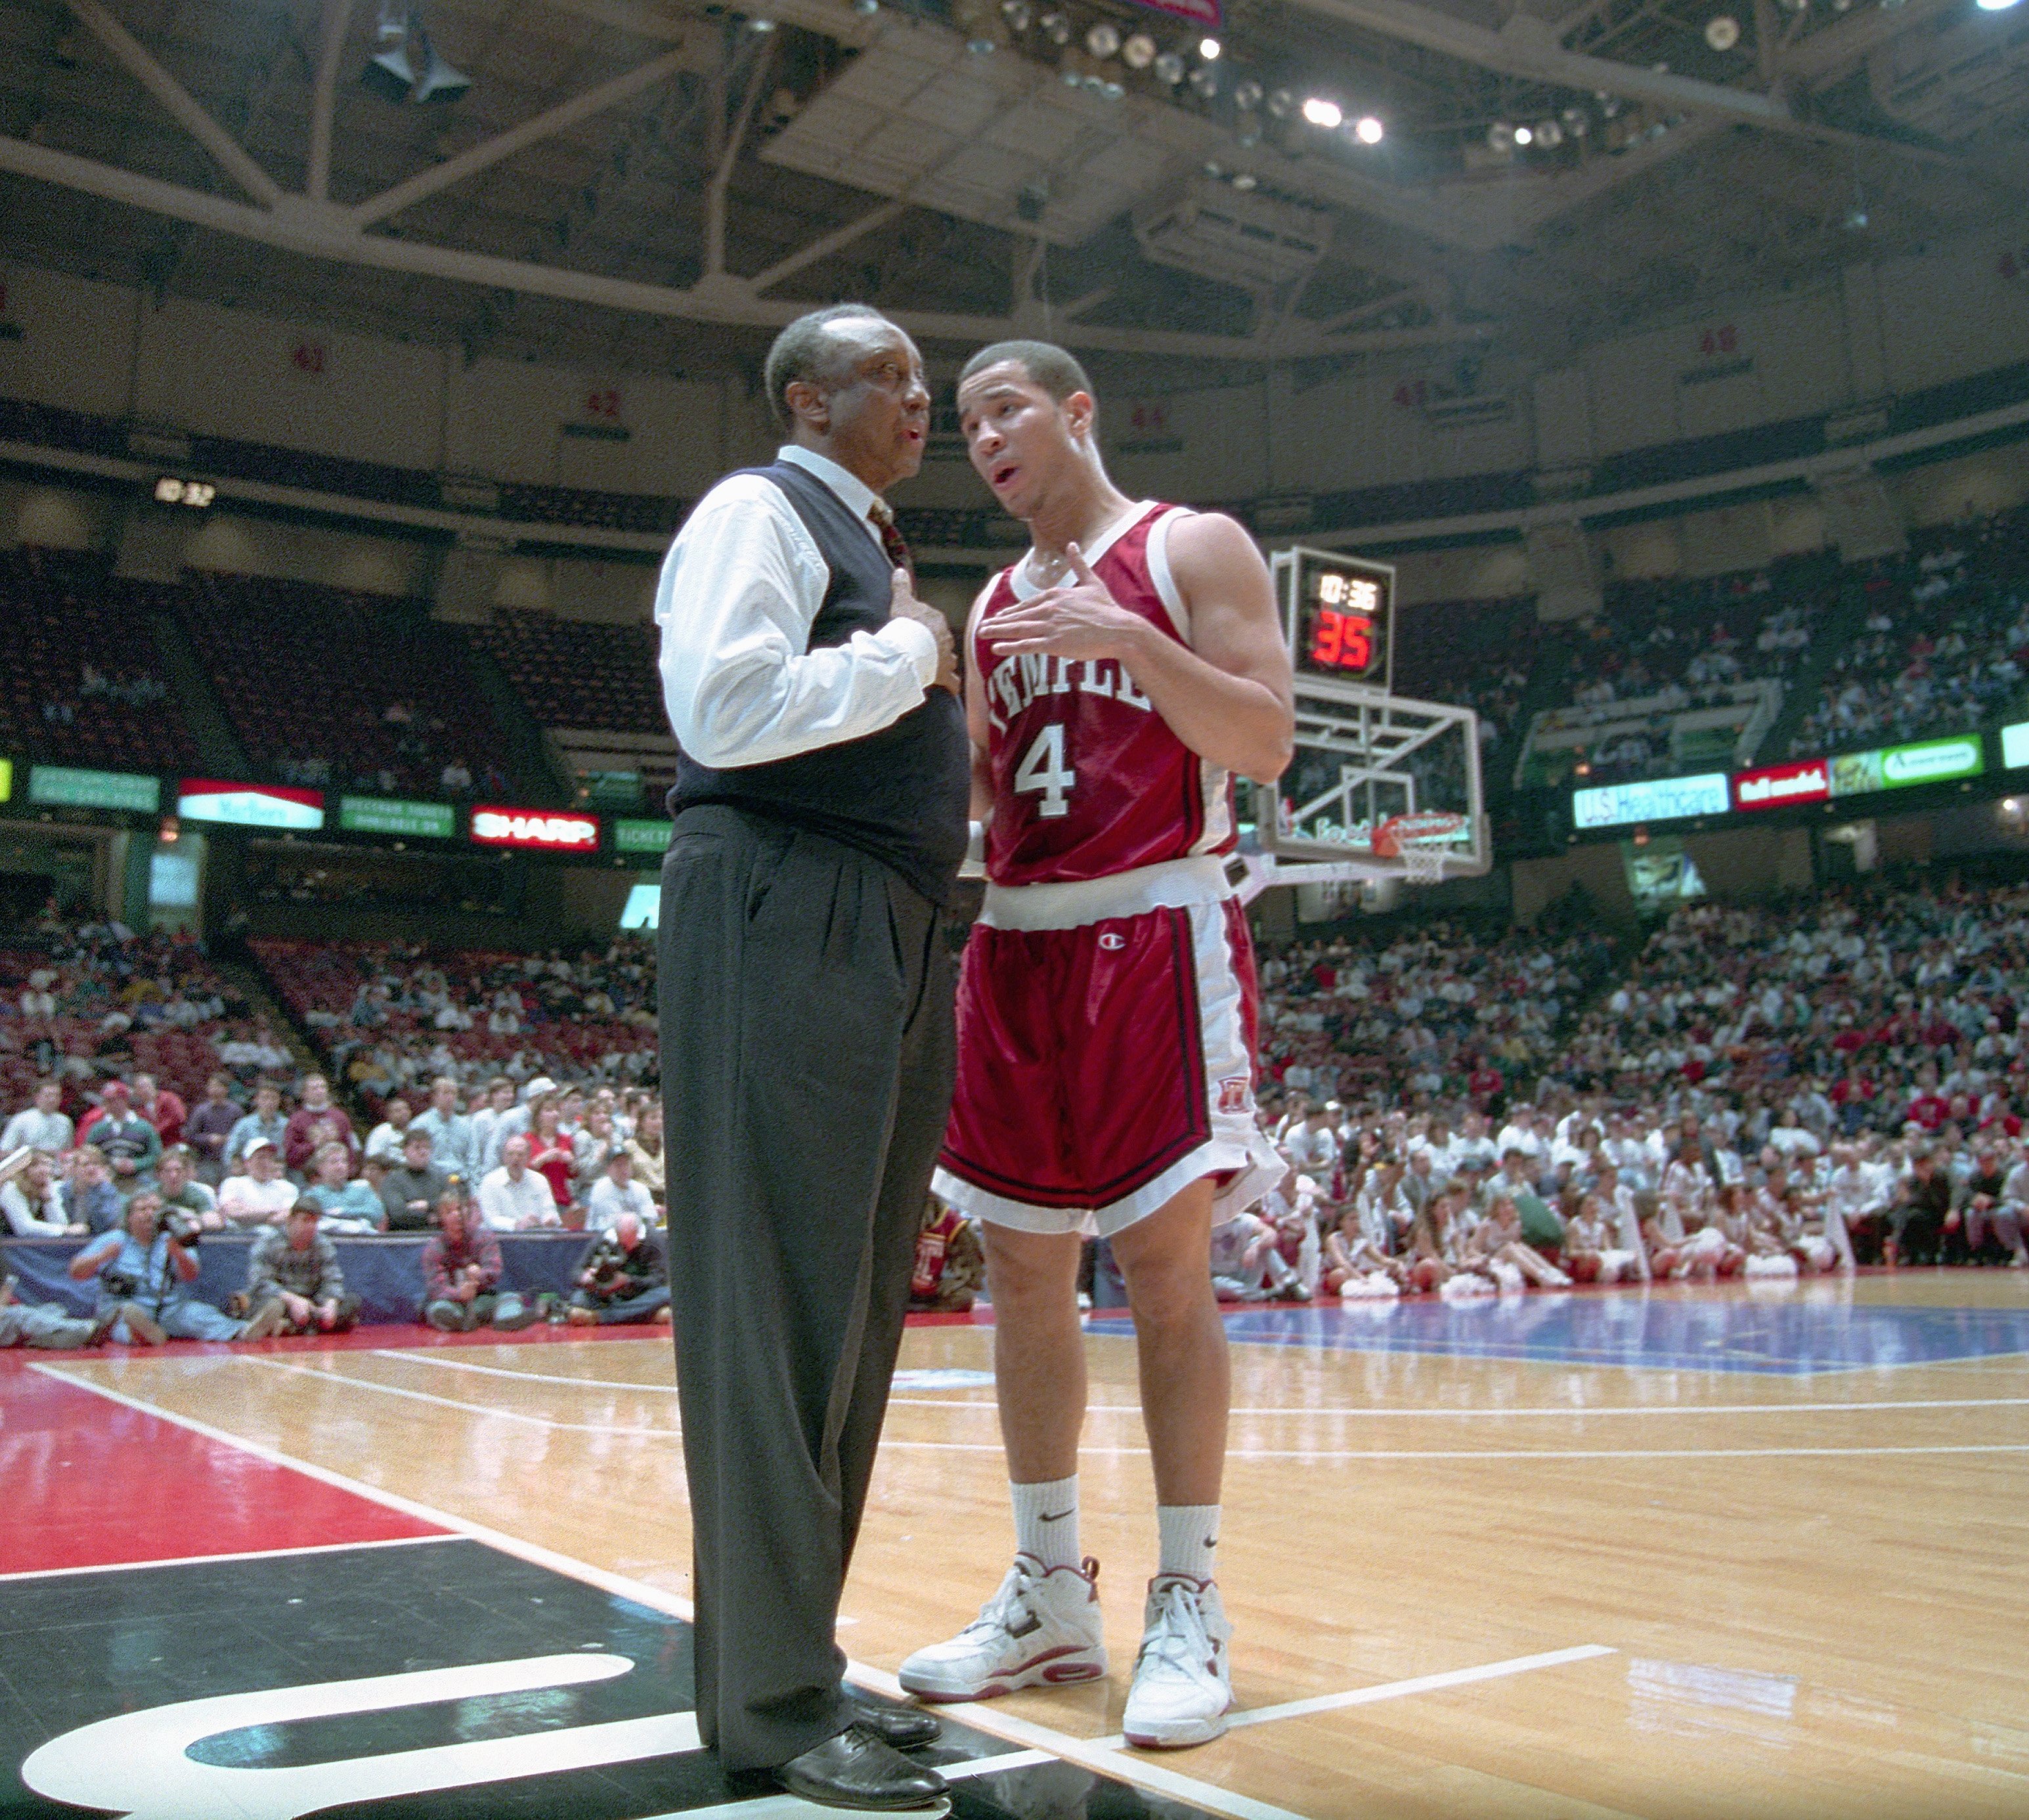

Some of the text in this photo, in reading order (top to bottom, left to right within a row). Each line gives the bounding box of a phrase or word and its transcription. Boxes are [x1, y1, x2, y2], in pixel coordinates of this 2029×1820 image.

[1320, 574, 1378, 611] 10:36
[1313, 610, 1372, 667] 35
[1014, 724, 1075, 817] 4
[473, 812, 596, 844] SHARP
